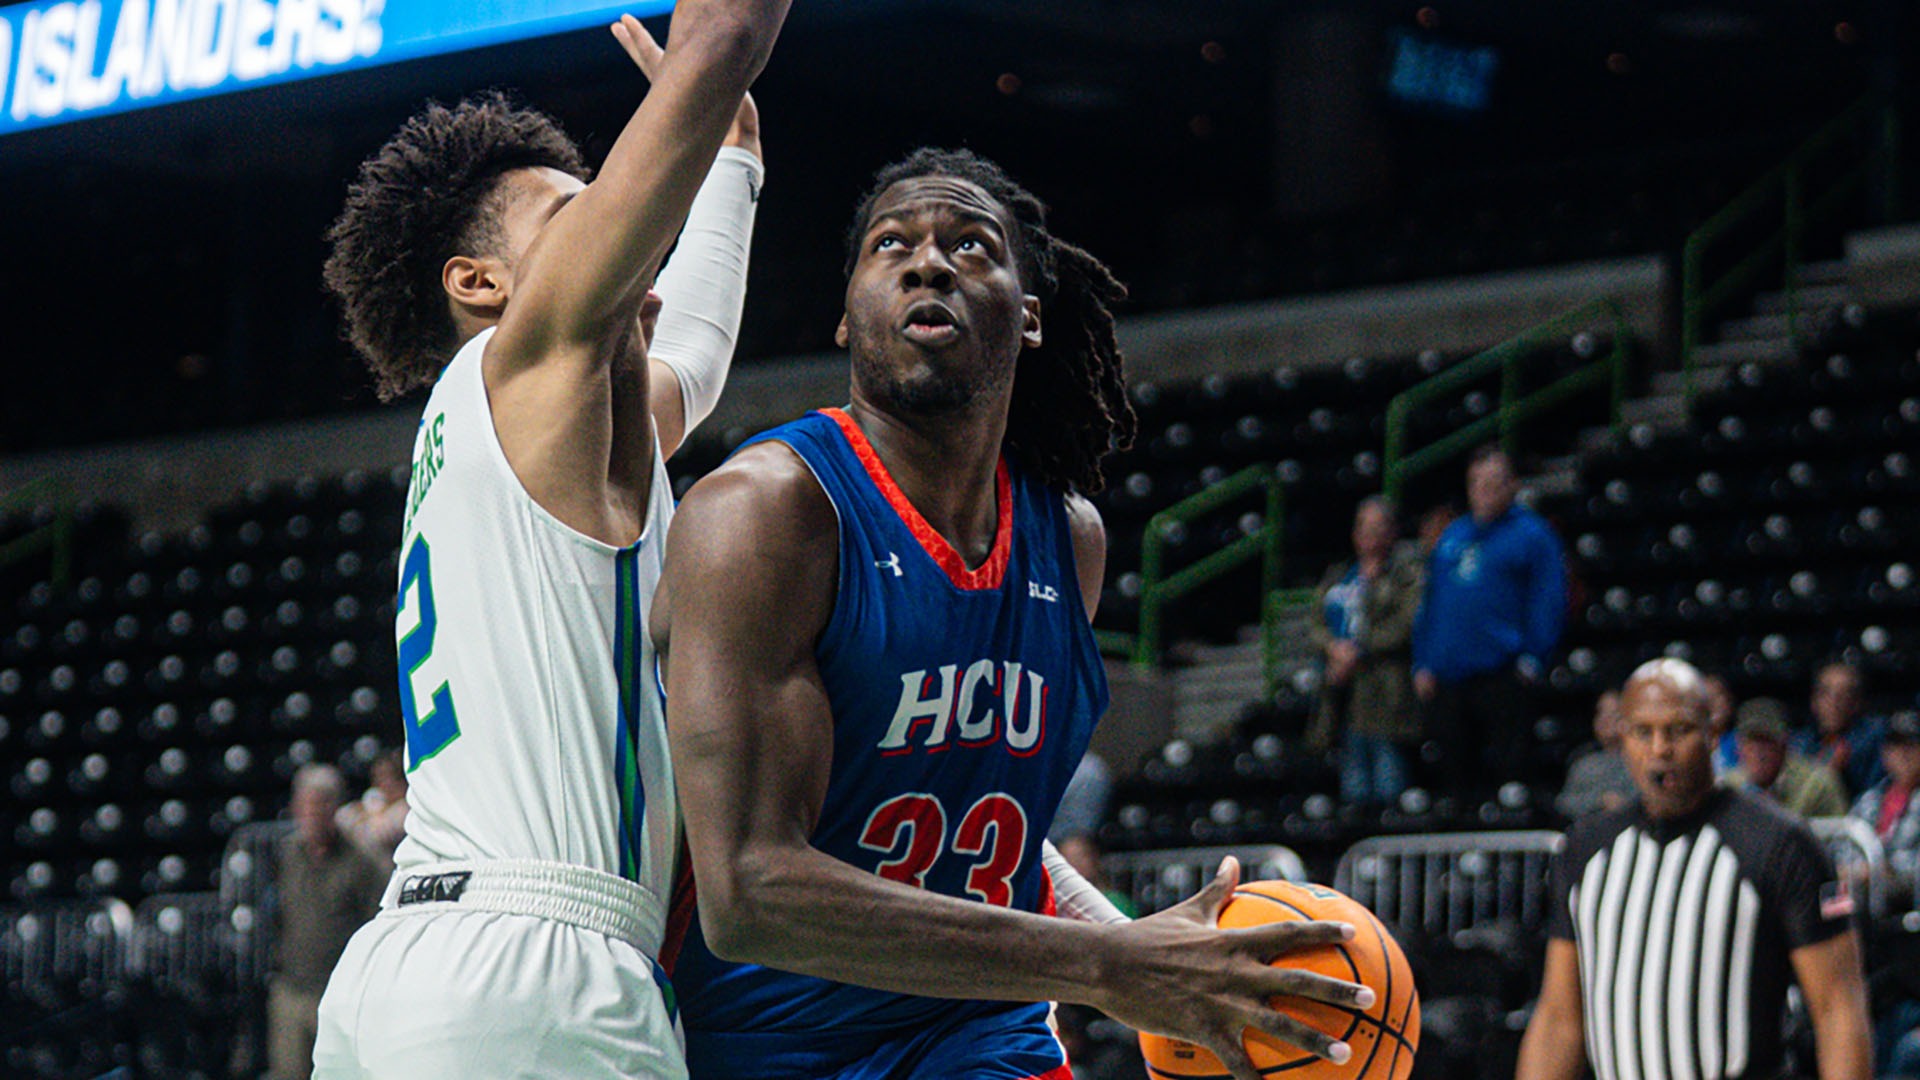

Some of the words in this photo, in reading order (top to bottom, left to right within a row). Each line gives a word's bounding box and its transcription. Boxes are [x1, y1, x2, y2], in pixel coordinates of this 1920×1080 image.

[397, 531, 461, 773] 2
[877, 658, 1048, 758] HCU
[857, 792, 1028, 909] 33
